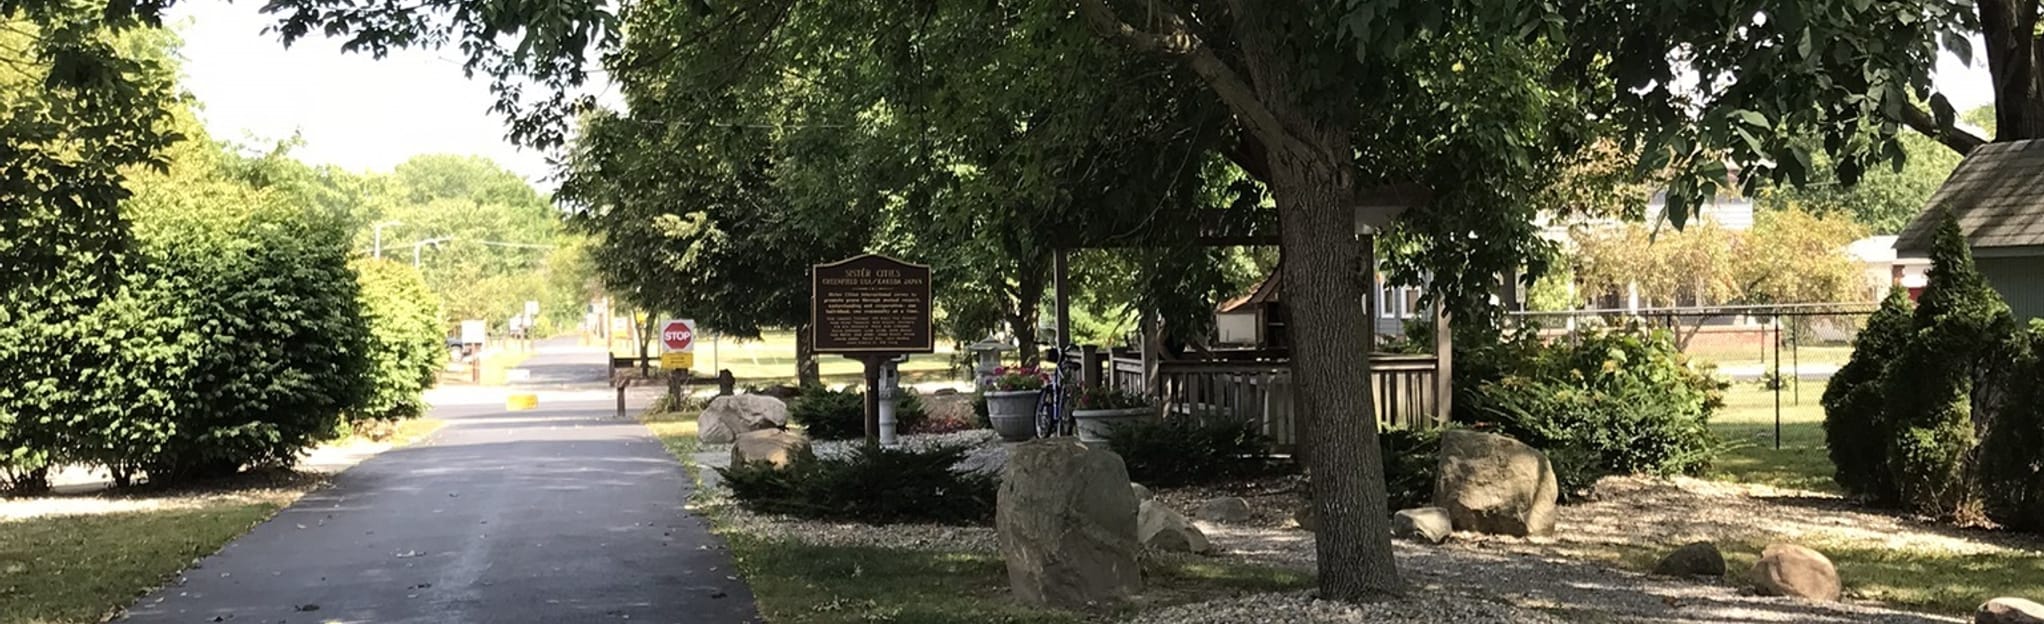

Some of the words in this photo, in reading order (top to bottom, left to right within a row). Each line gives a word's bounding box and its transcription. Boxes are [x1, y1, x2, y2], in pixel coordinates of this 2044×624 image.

[845, 268, 872, 277] SISTER
[876, 269, 901, 277] CITIES
[665, 331, 691, 342] STOP
